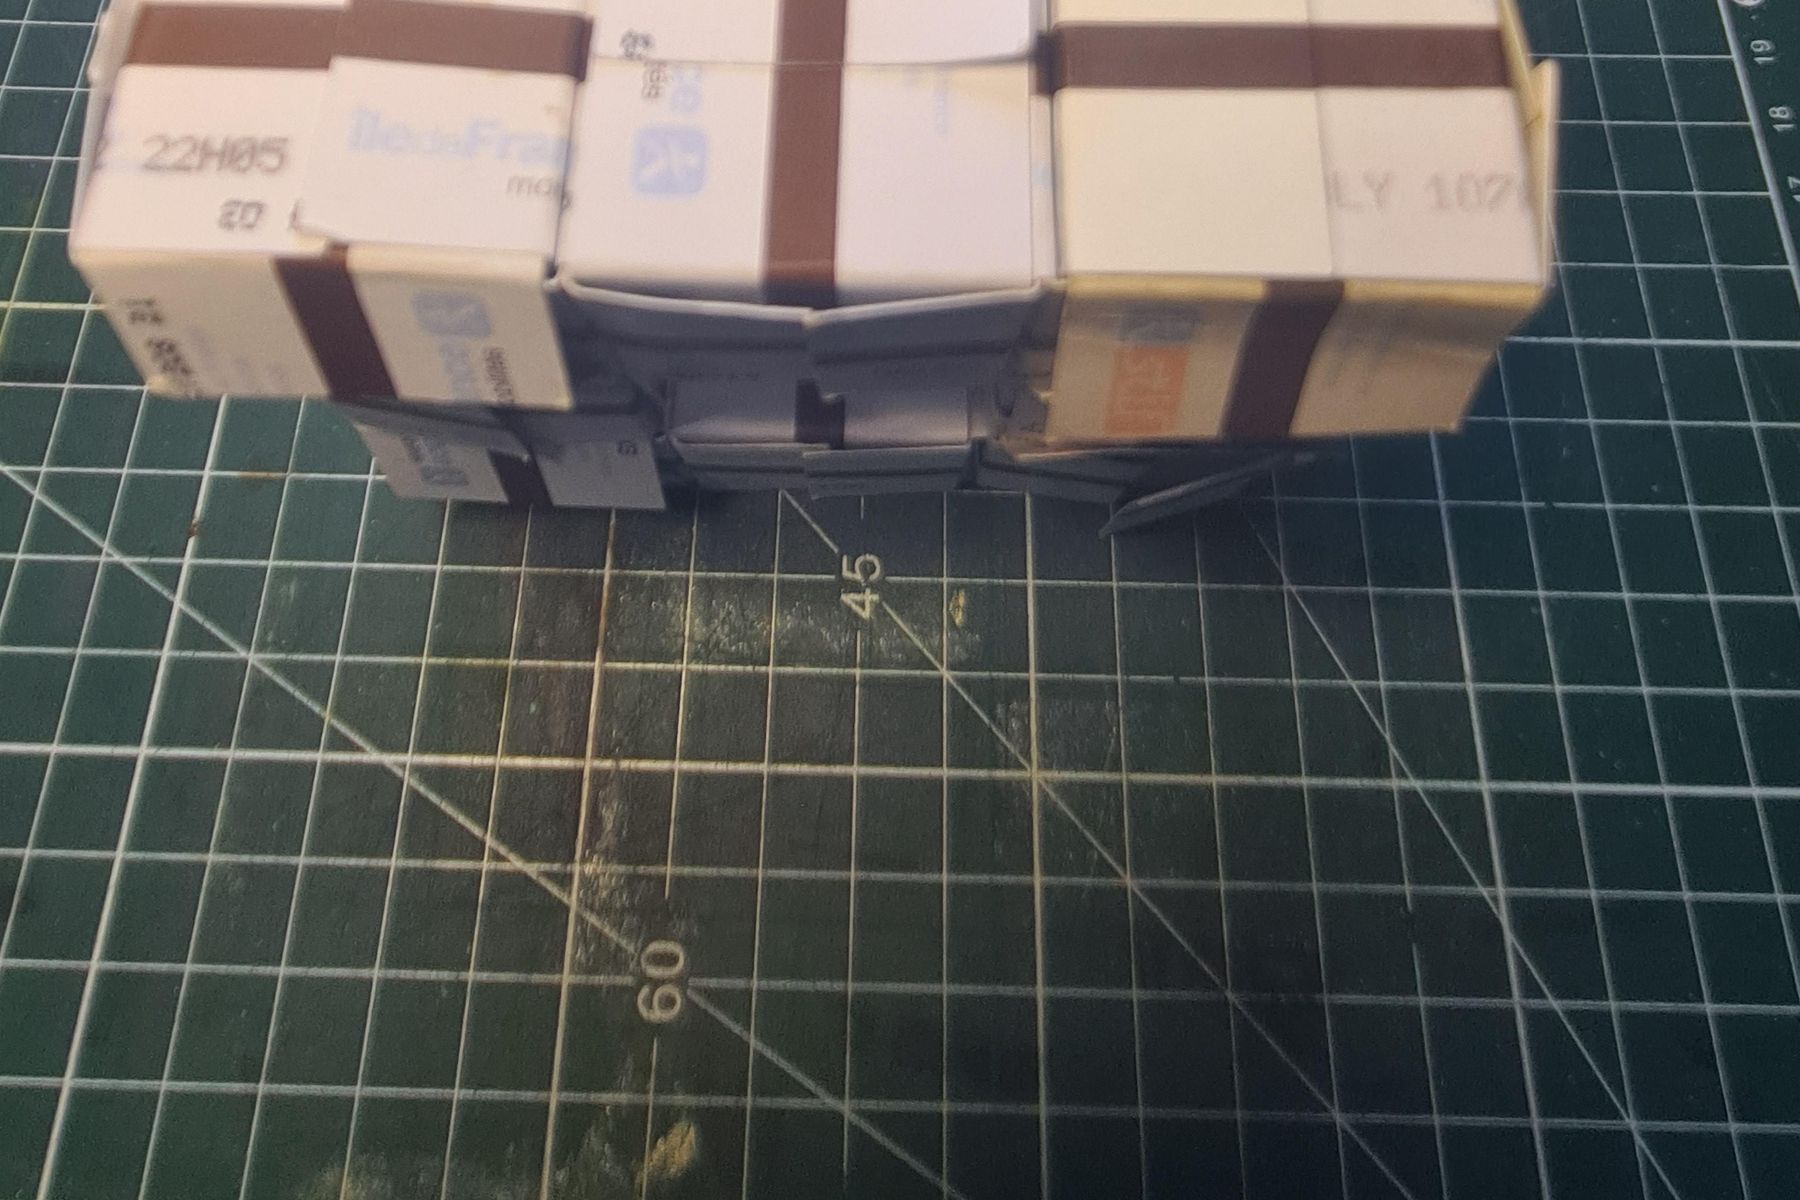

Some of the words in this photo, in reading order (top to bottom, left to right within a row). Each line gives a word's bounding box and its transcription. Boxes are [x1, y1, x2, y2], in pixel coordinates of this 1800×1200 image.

[1750, 38, 1776, 65] 19
[1768, 104, 1796, 132] 18
[142, 133, 289, 174] 22H05
[841, 552, 884, 620] 45
[637, 939, 687, 1024] 60
